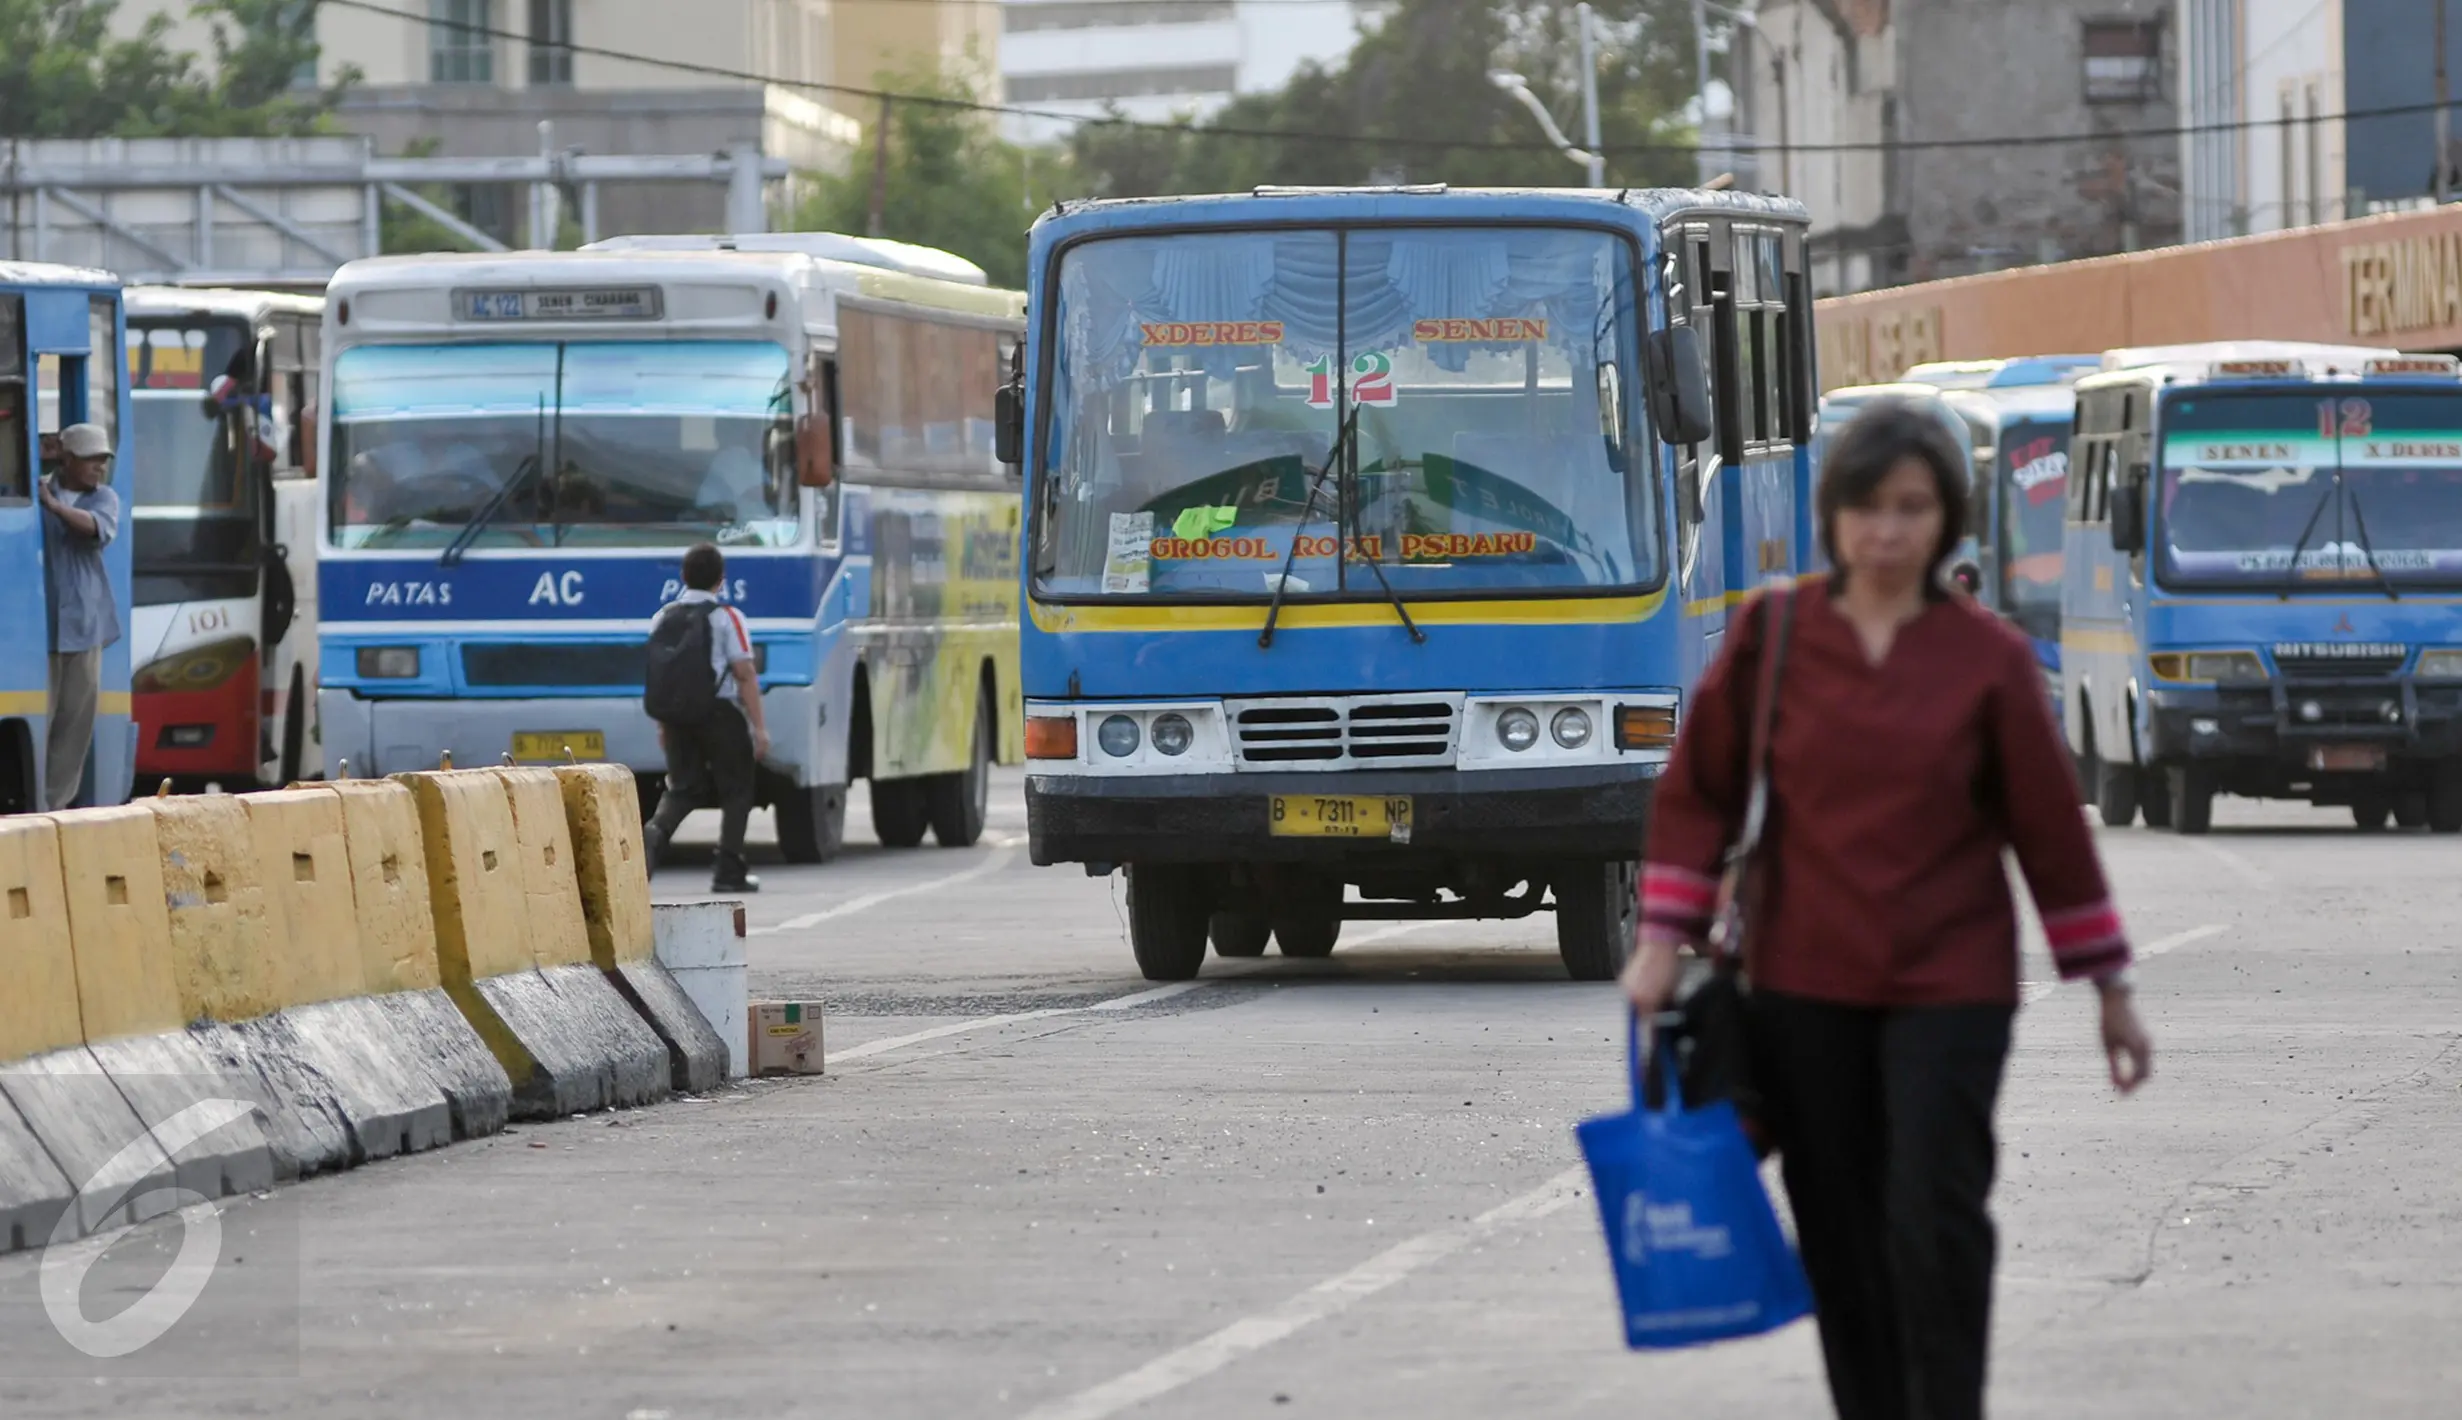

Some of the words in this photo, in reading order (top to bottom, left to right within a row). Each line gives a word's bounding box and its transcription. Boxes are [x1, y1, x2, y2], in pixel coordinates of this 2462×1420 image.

[472, 293, 490, 316] AC
[496, 293, 521, 316] 122
[1411, 319, 1548, 342] SENEN
[1304, 351, 1398, 410] 12
[2316, 397, 2373, 440] 12
[2206, 444, 2289, 461] SENEN
[1149, 534, 1279, 560] GROGOL
[366, 581, 453, 606] PATAS
[528, 571, 585, 606] AC
[660, 579, 748, 602] PAS
[2273, 643, 2407, 657] MITSUBISHI
[1273, 798, 1285, 822] B
[1314, 799, 1355, 822] 7311
[1384, 800, 1409, 823] NP
